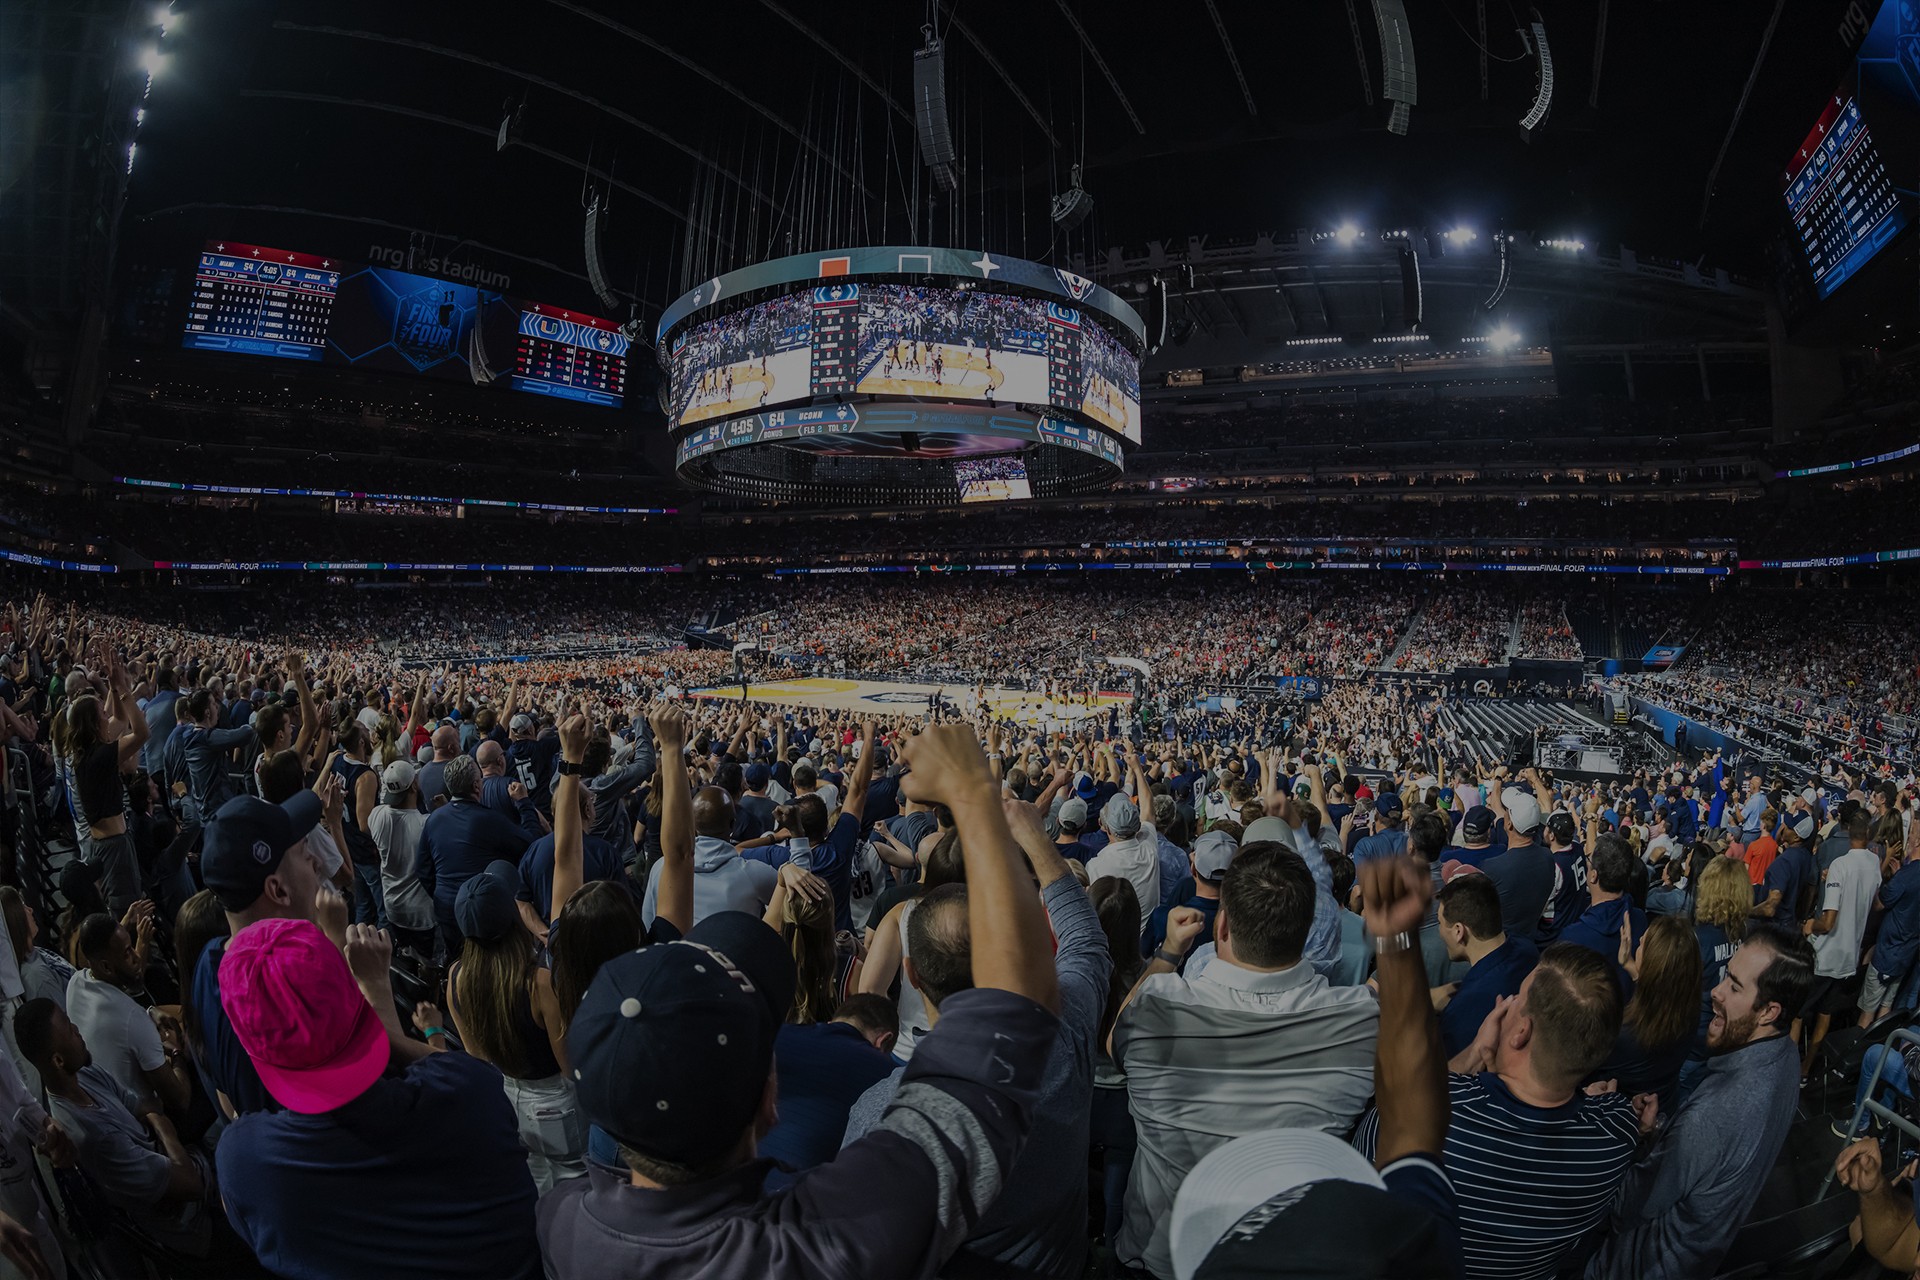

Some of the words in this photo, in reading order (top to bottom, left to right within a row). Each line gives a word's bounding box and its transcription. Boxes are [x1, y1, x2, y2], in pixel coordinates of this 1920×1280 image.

[1838, 1, 1869, 48] nrg
[243, 262, 254, 272] 54
[263, 266, 278, 275] 4:05
[286, 269, 296, 278] 64
[368, 244, 404, 270] nrg
[428, 256, 510, 289] stadium
[408, 323, 452, 347] FOUR
[541, 320, 558, 335] U
[769, 412, 785, 427] 64
[798, 411, 823, 421] UCONN
[709, 426, 720, 440] 54
[730, 418, 754, 436] 4:05
[764, 430, 783, 439] BONUS
[804, 426, 815, 434] FLS
[828, 424, 840, 432] TOL
[1043, 418, 1056, 430] U
[1087, 428, 1097, 444] 54
[741, 435, 753, 443] HALF
[1810, 558, 1828, 567] FINAL
[1828, 557, 1844, 566] FOUR
[516, 762, 537, 790] 15
[1571, 856, 1587, 891] 15
